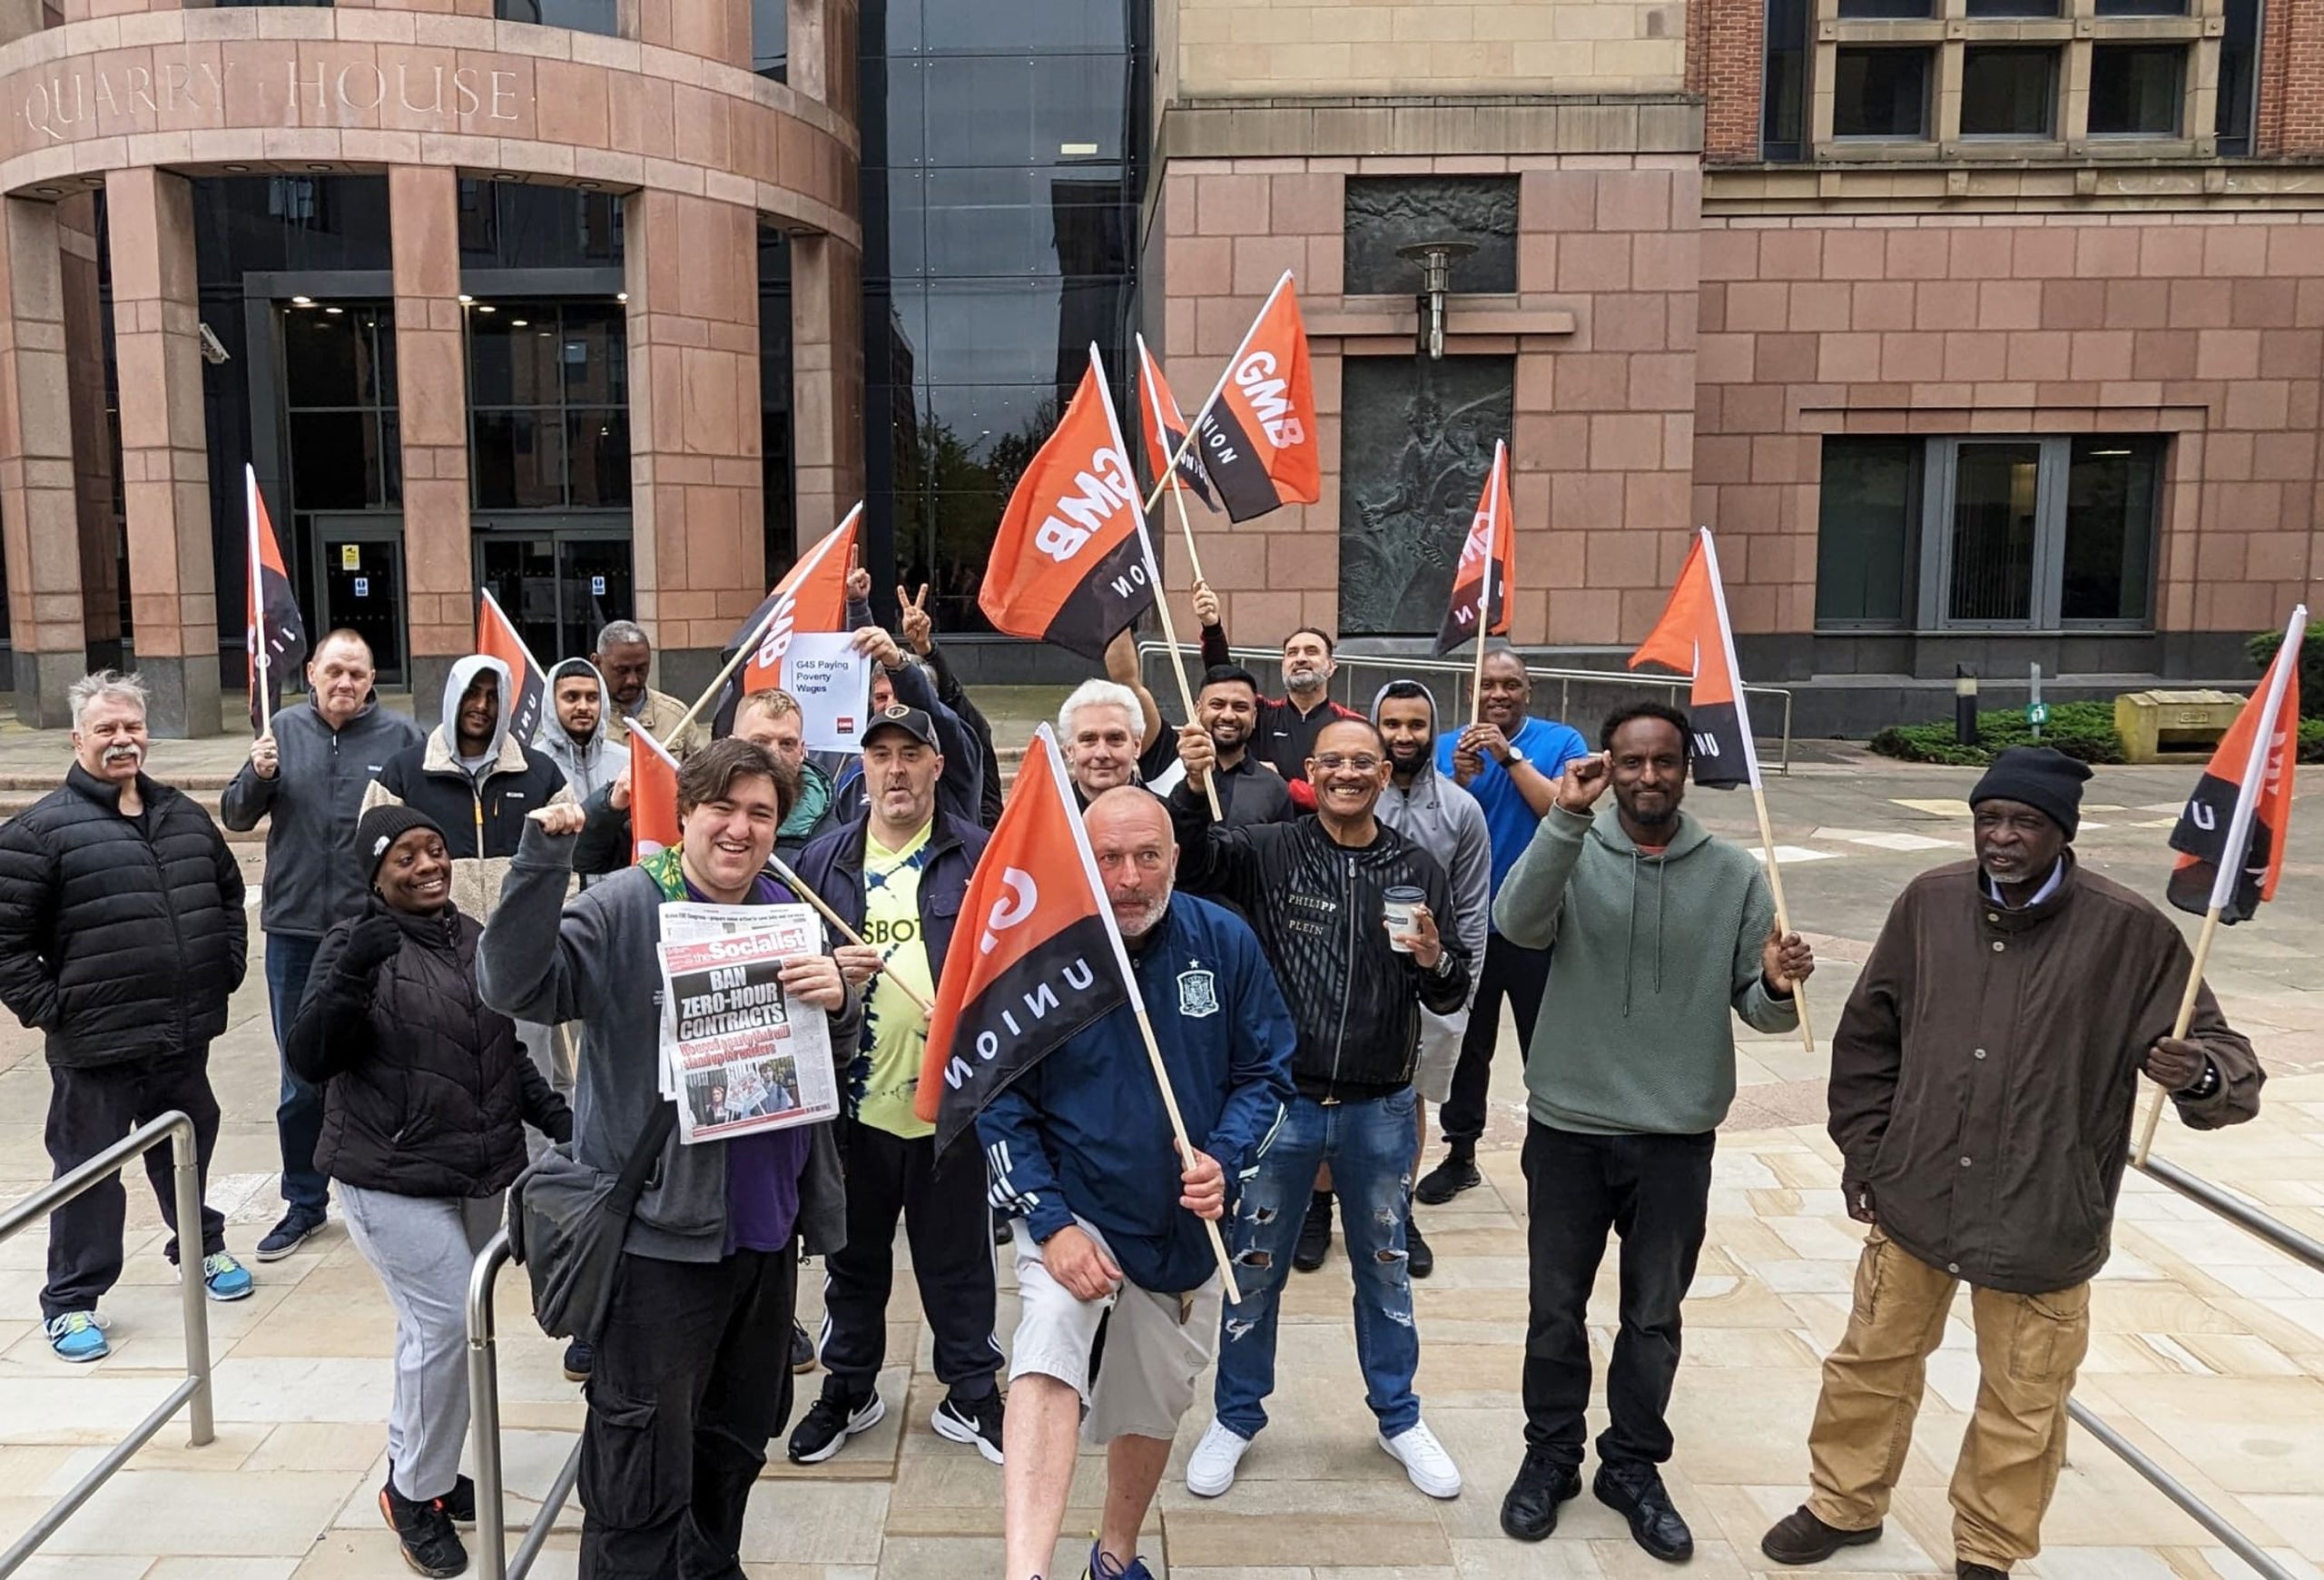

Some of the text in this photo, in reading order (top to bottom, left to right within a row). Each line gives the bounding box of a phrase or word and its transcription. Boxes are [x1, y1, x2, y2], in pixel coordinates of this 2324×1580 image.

[25, 60, 518, 141] QUARRY HOUSE
[1235, 351, 1305, 449] GMB
[1202, 414, 1238, 464] NION
[759, 598, 796, 668] MB
[796, 660, 849, 671] G4S Paying
[796, 672, 832, 683] Poverty
[796, 684, 827, 695] Wages
[1288, 894, 1337, 913] PHILIPP
[1288, 920, 1324, 936] PLEIN
[708, 929, 806, 960] Socialist
[710, 966, 746, 992] BAN
[681, 982, 778, 1020] ZERO-HOUR
[680, 1002, 786, 1041] CONTRACTS
